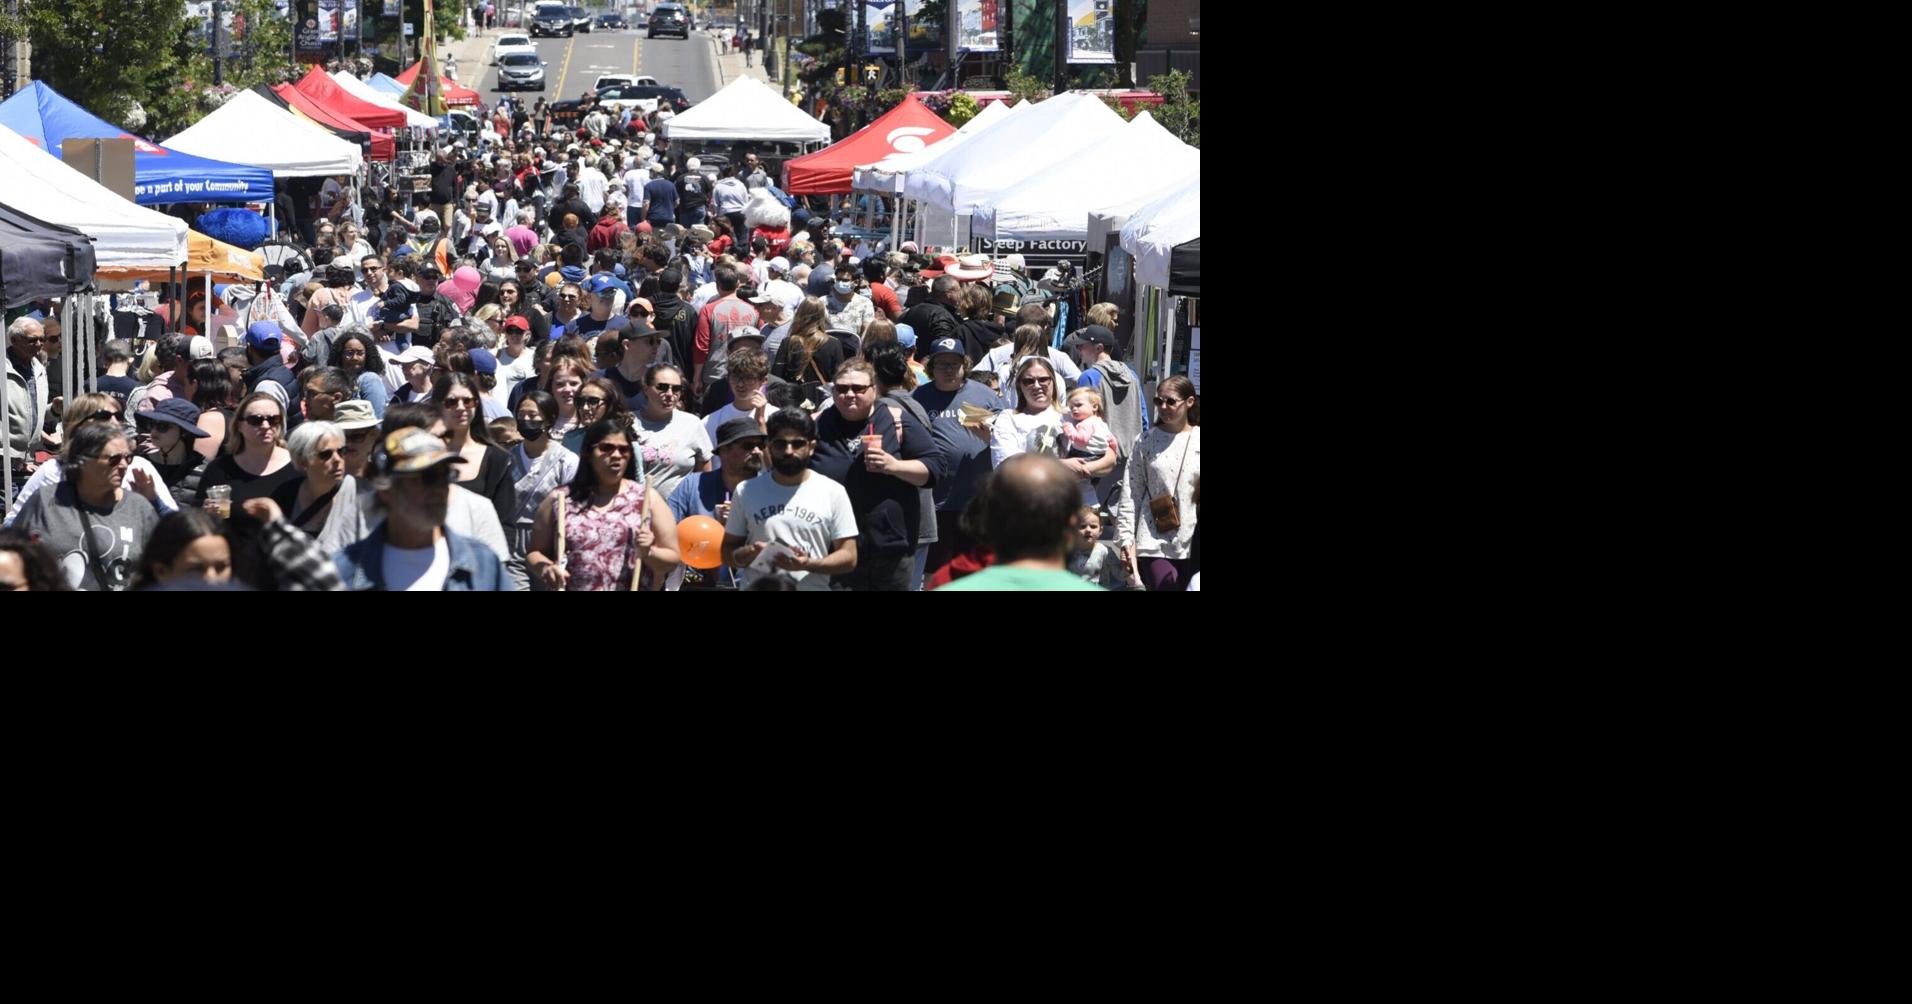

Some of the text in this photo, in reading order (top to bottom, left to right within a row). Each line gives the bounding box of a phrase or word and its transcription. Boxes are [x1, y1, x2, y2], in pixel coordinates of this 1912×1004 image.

[155, 181, 173, 196] part
[174, 179, 184, 192] of
[185, 182, 204, 195] your
[205, 179, 249, 195] Community
[1029, 239, 1087, 253] Factory
[752, 503, 824, 527] AERO-1987
